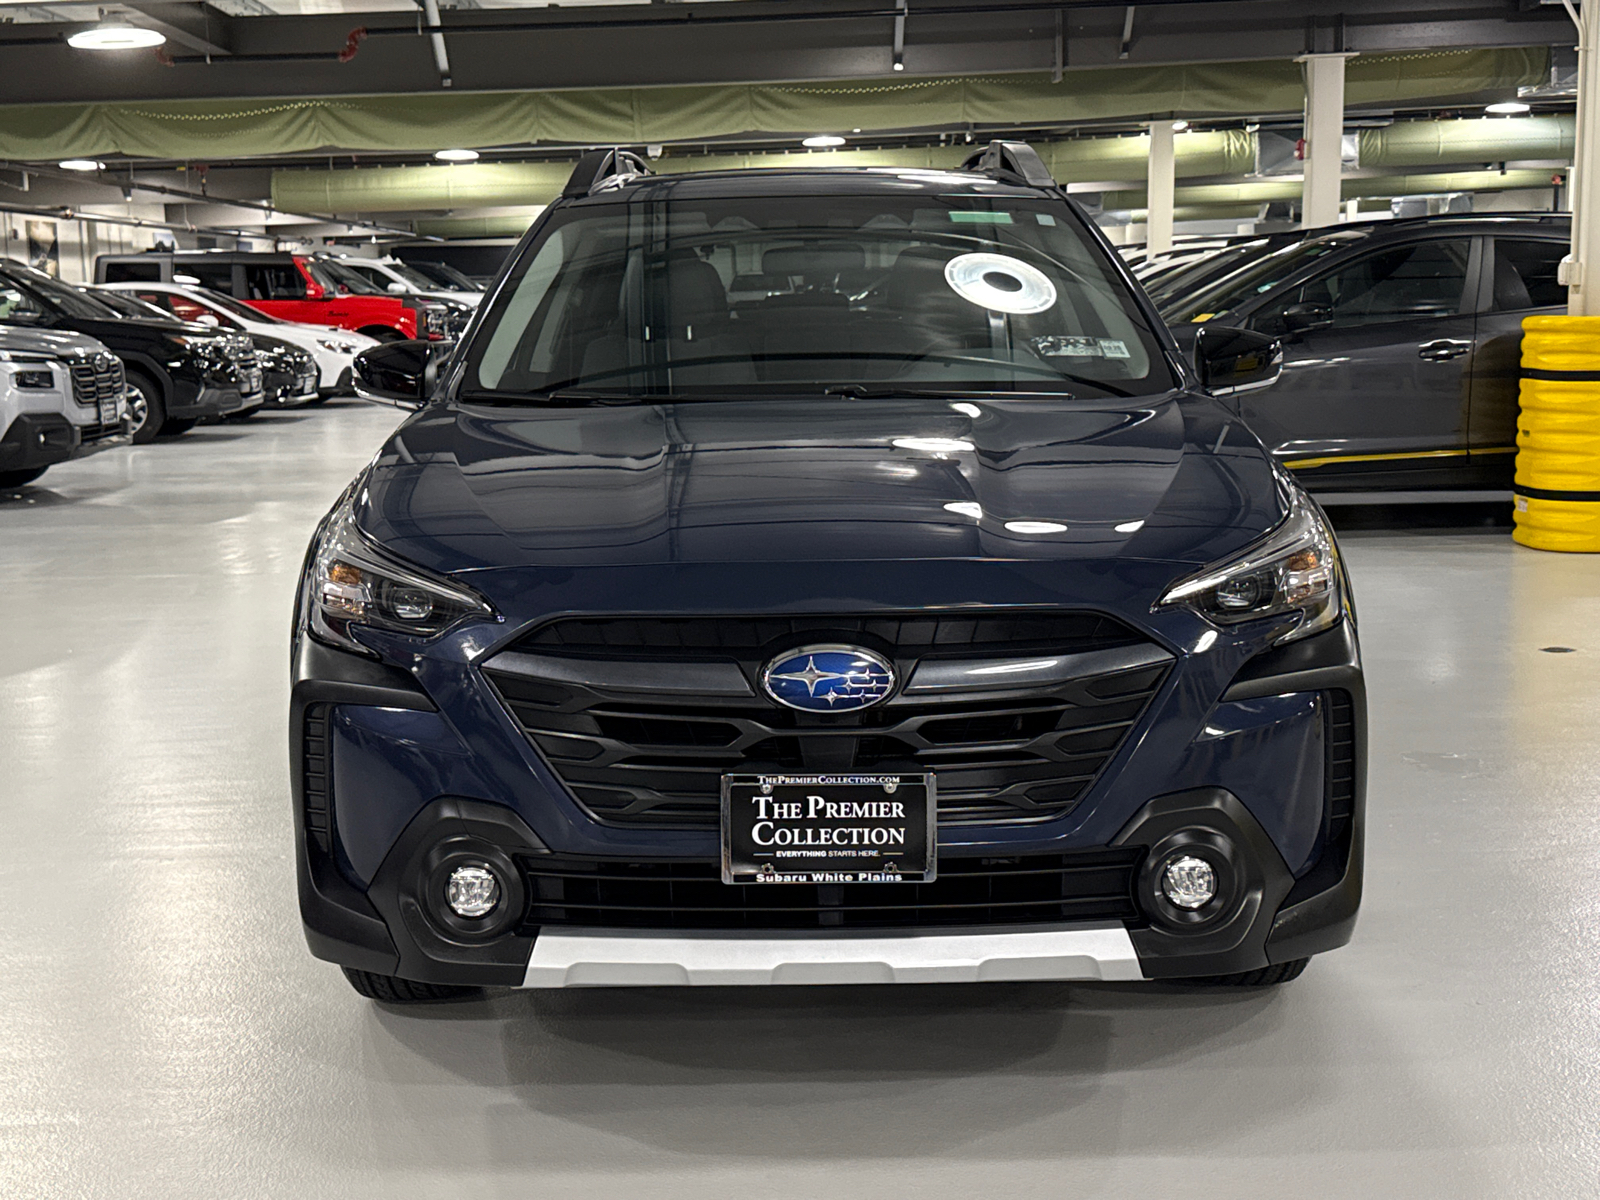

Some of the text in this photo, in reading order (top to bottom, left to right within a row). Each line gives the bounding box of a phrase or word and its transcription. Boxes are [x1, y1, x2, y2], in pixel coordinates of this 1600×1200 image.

[752, 795, 905, 819] THE PREMIER
[752, 821, 905, 846] COLLECTION
[776, 850, 827, 858] EVERYTHING
[756, 872, 903, 882] Subaru White Plains
